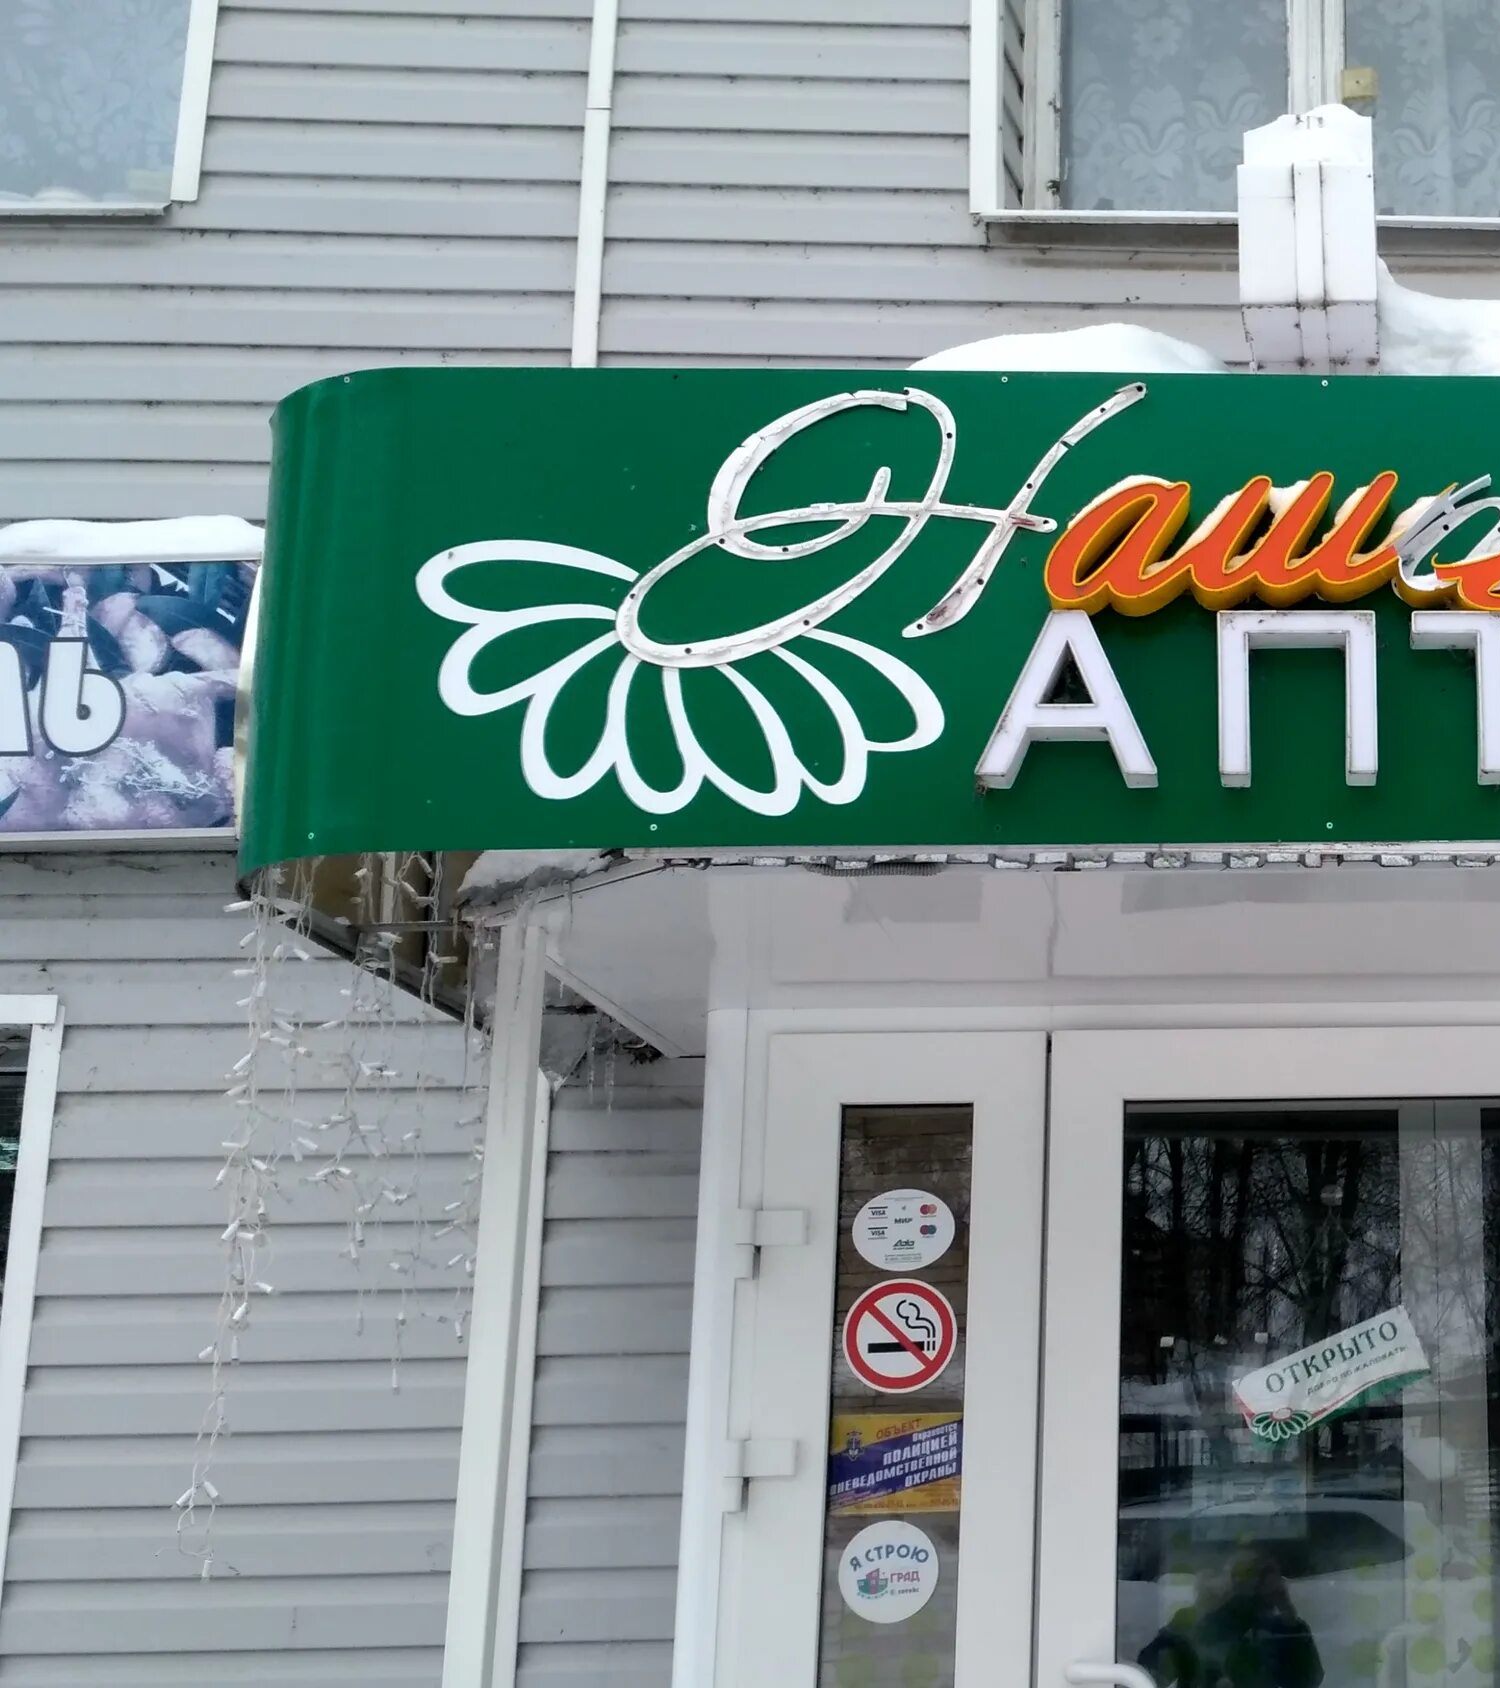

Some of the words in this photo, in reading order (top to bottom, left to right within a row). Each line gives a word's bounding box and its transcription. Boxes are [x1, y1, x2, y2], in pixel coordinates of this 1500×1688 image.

[1265, 1321, 1398, 1393] ОТКРЫТО
[876, 1418, 923, 1440] ОБЪЕКТ
[883, 1431, 958, 1466] ПОЛИЦИЕЙ
[830, 1449, 958, 1497] ВНЕВЕДОМСТВЕННОЙ
[905, 1462, 957, 1488] ОХРАНЫ
[849, 1556, 862, 1572] Я
[865, 1543, 929, 1564] СТРОЮ
[890, 1570, 921, 1584] ГРАД
